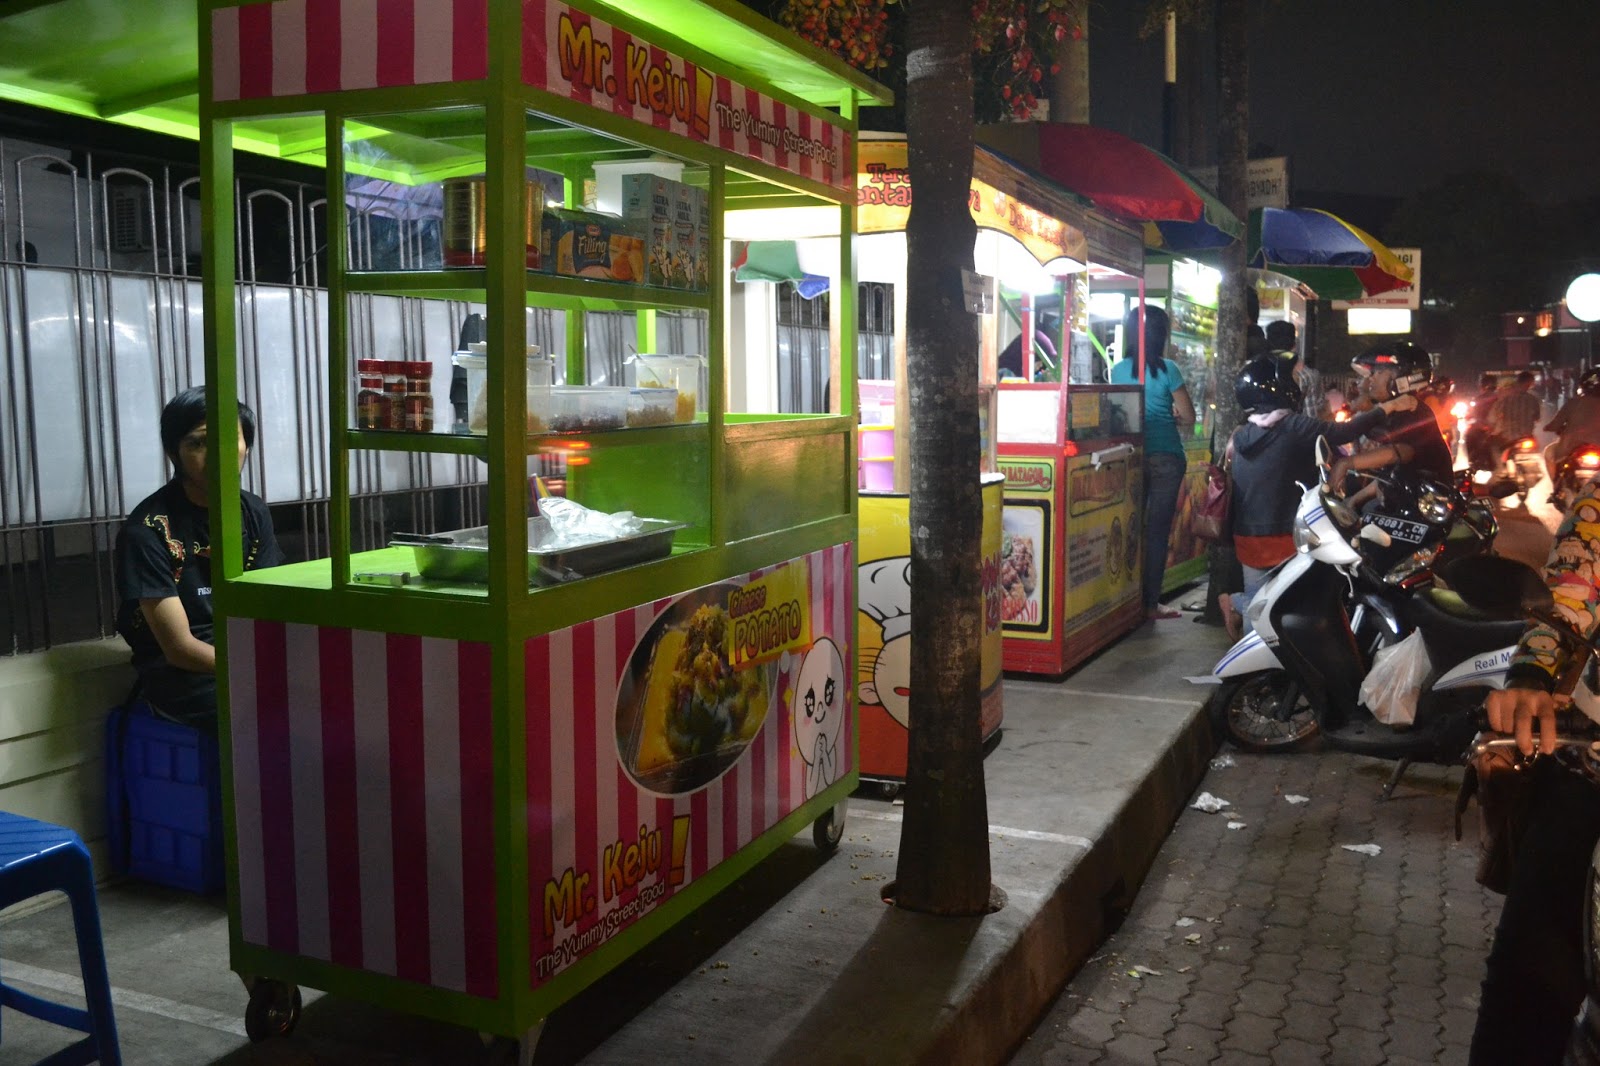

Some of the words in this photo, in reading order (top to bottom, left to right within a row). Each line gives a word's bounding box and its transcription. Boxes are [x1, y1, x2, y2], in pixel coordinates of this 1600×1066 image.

[558, 13, 617, 97] Mr.
[715, 102, 741, 131] The
[741, 109, 782, 151] Yummy
[782, 128, 814, 158] Street
[813, 139, 839, 168] Food
[578, 235, 608, 264] Filling
[1377, 516, 1405, 530] 6081
[729, 583, 767, 620] Cheese
[733, 598, 802, 664] POTATO
[1474, 655, 1498, 671] Real
[535, 944, 562, 980] The
[561, 918, 606, 964] Yummy
[604, 898, 641, 936] Street
[639, 880, 666, 915] Food
[543, 866, 596, 939] Mr.
